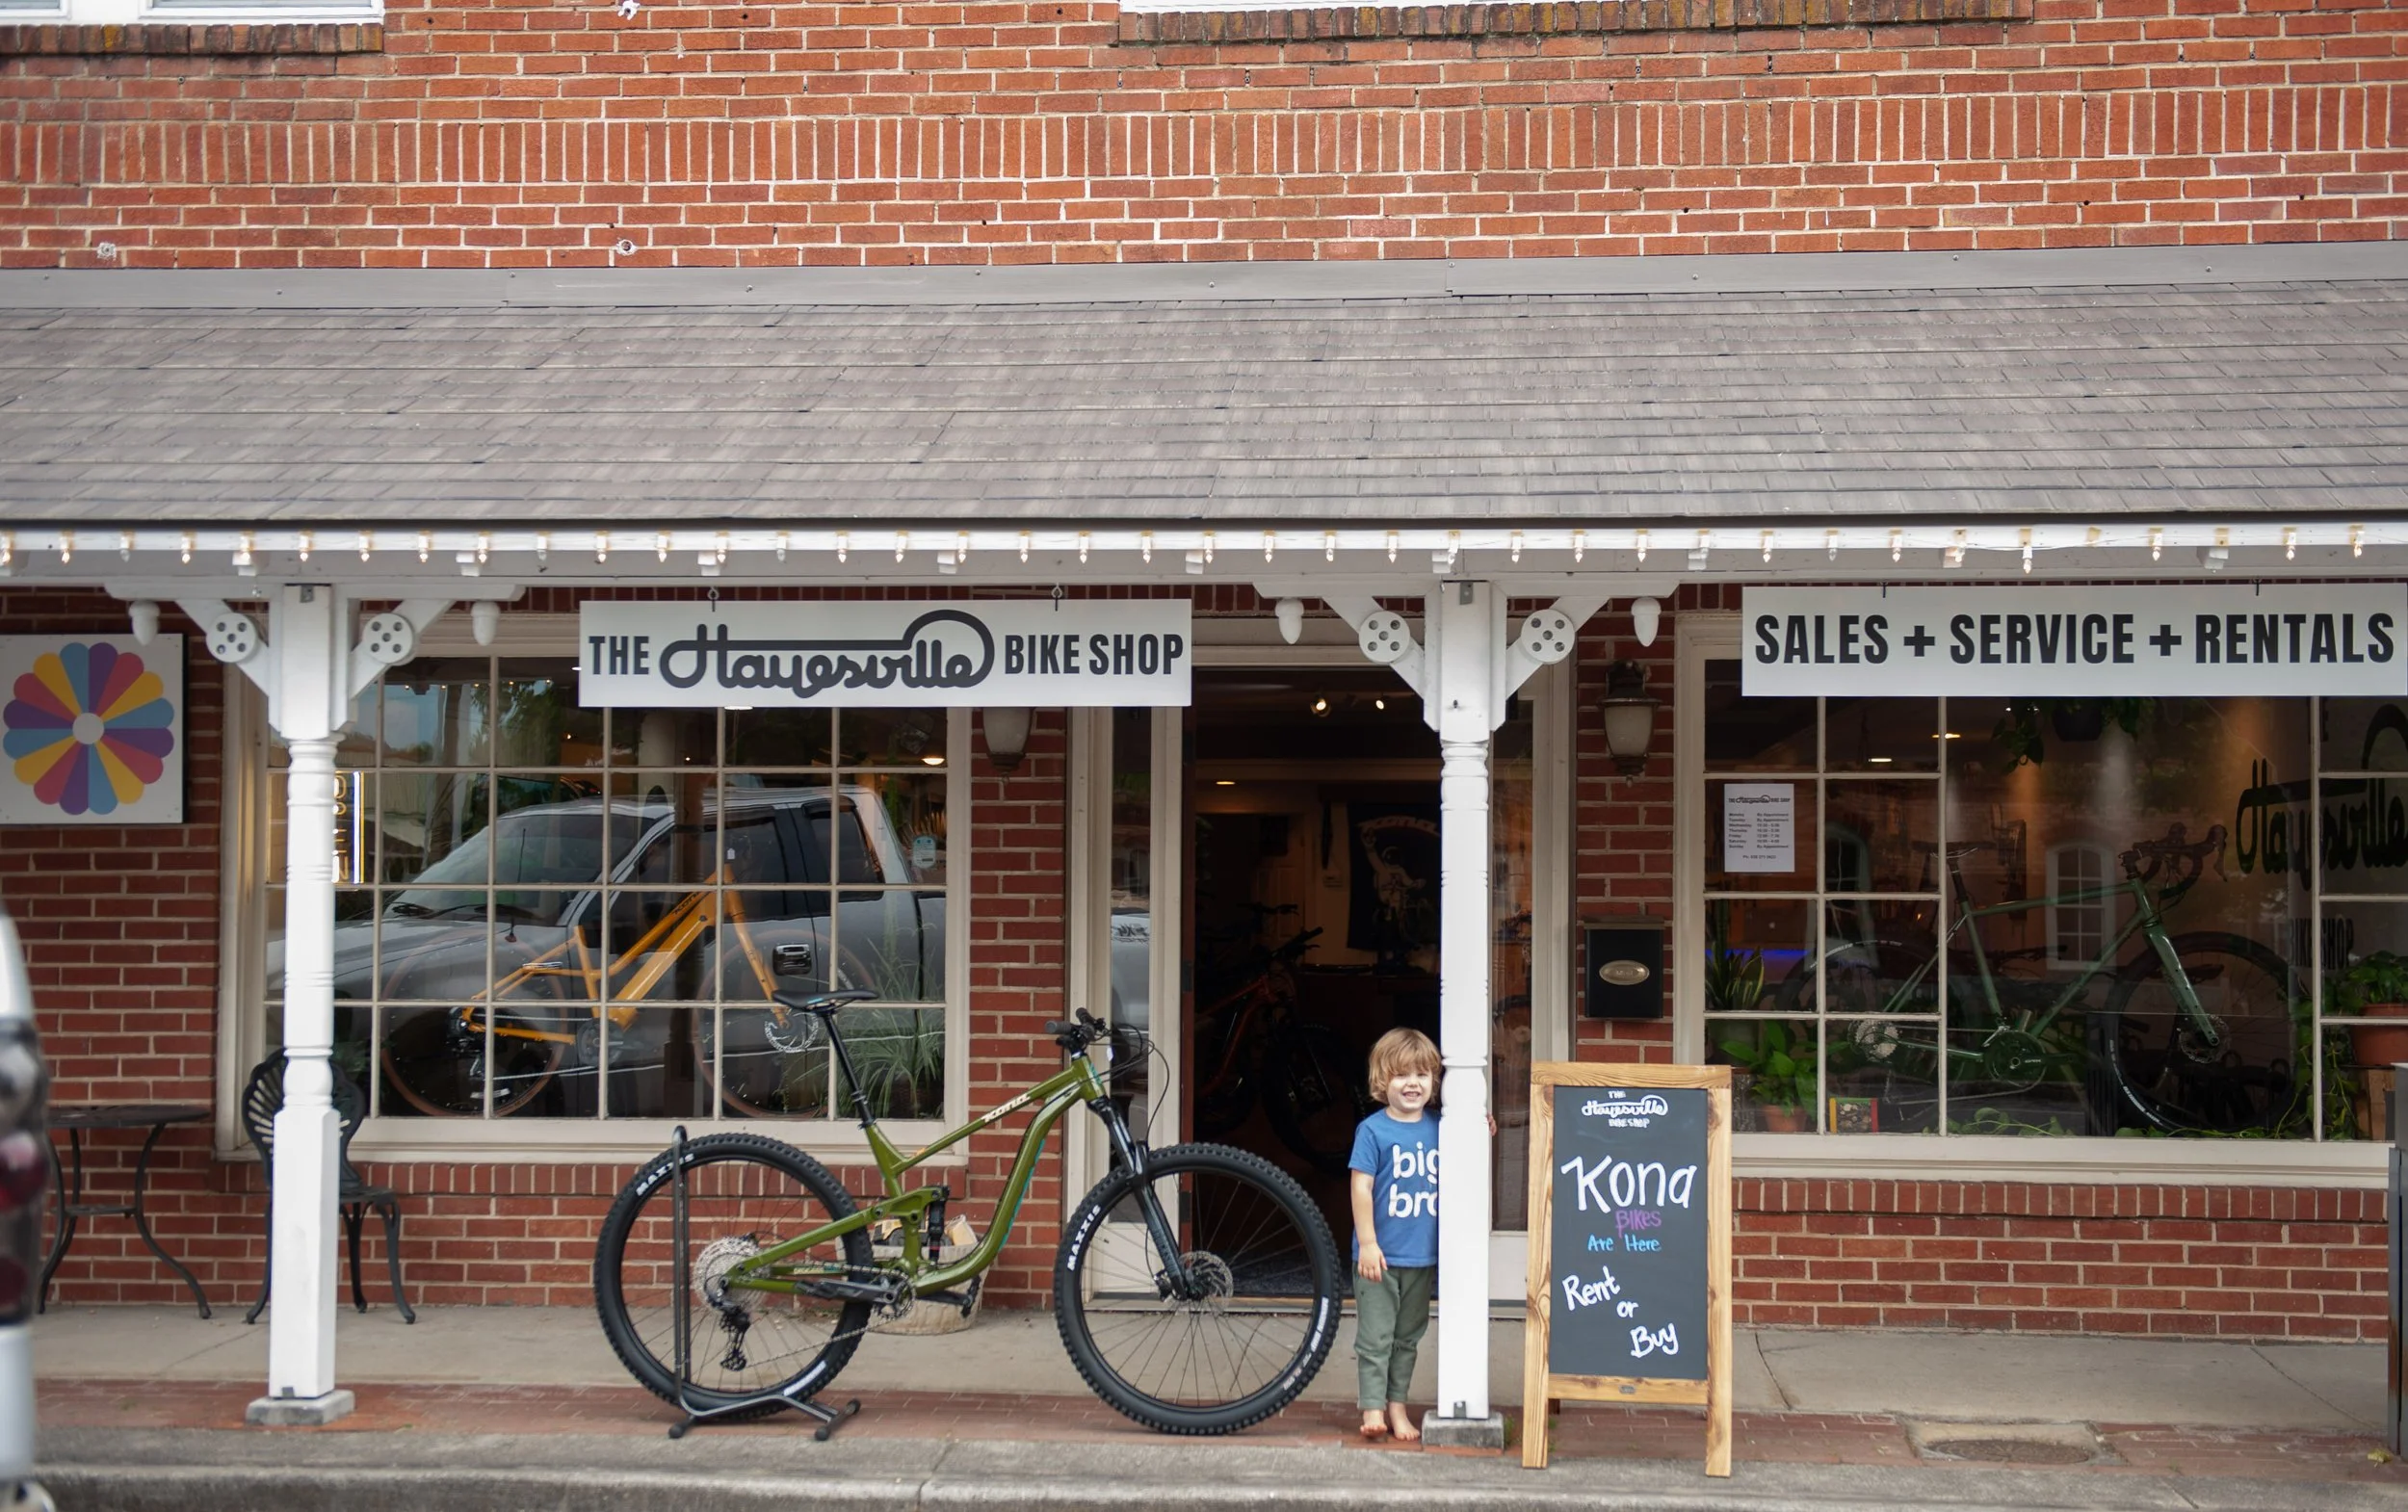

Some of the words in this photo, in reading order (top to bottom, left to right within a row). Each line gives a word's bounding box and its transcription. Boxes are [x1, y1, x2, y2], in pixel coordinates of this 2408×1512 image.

[589, 636, 650, 675] THE
[659, 610, 995, 699] Hayesville
[1004, 634, 1080, 675] BIKE
[1089, 633, 1184, 675] SHOP
[1755, 613, 1889, 665] SALES
[1950, 613, 2135, 665] SERVICE
[2195, 612, 2395, 664] RENTALS
[2236, 704, 2408, 892] Haysville
[1582, 1094, 1668, 1118] Hayesville
[1608, 1090, 1626, 1099] THE
[1560, 1155, 1697, 1213] Kona
[1067, 1205, 1101, 1271] MAXXIS
[1587, 1234, 1614, 1251] Are
[1624, 1233, 1662, 1252] Here
[1561, 1265, 1621, 1311] Rent
[1616, 1300, 1639, 1318] or
[1630, 1322, 1679, 1359] Buy
